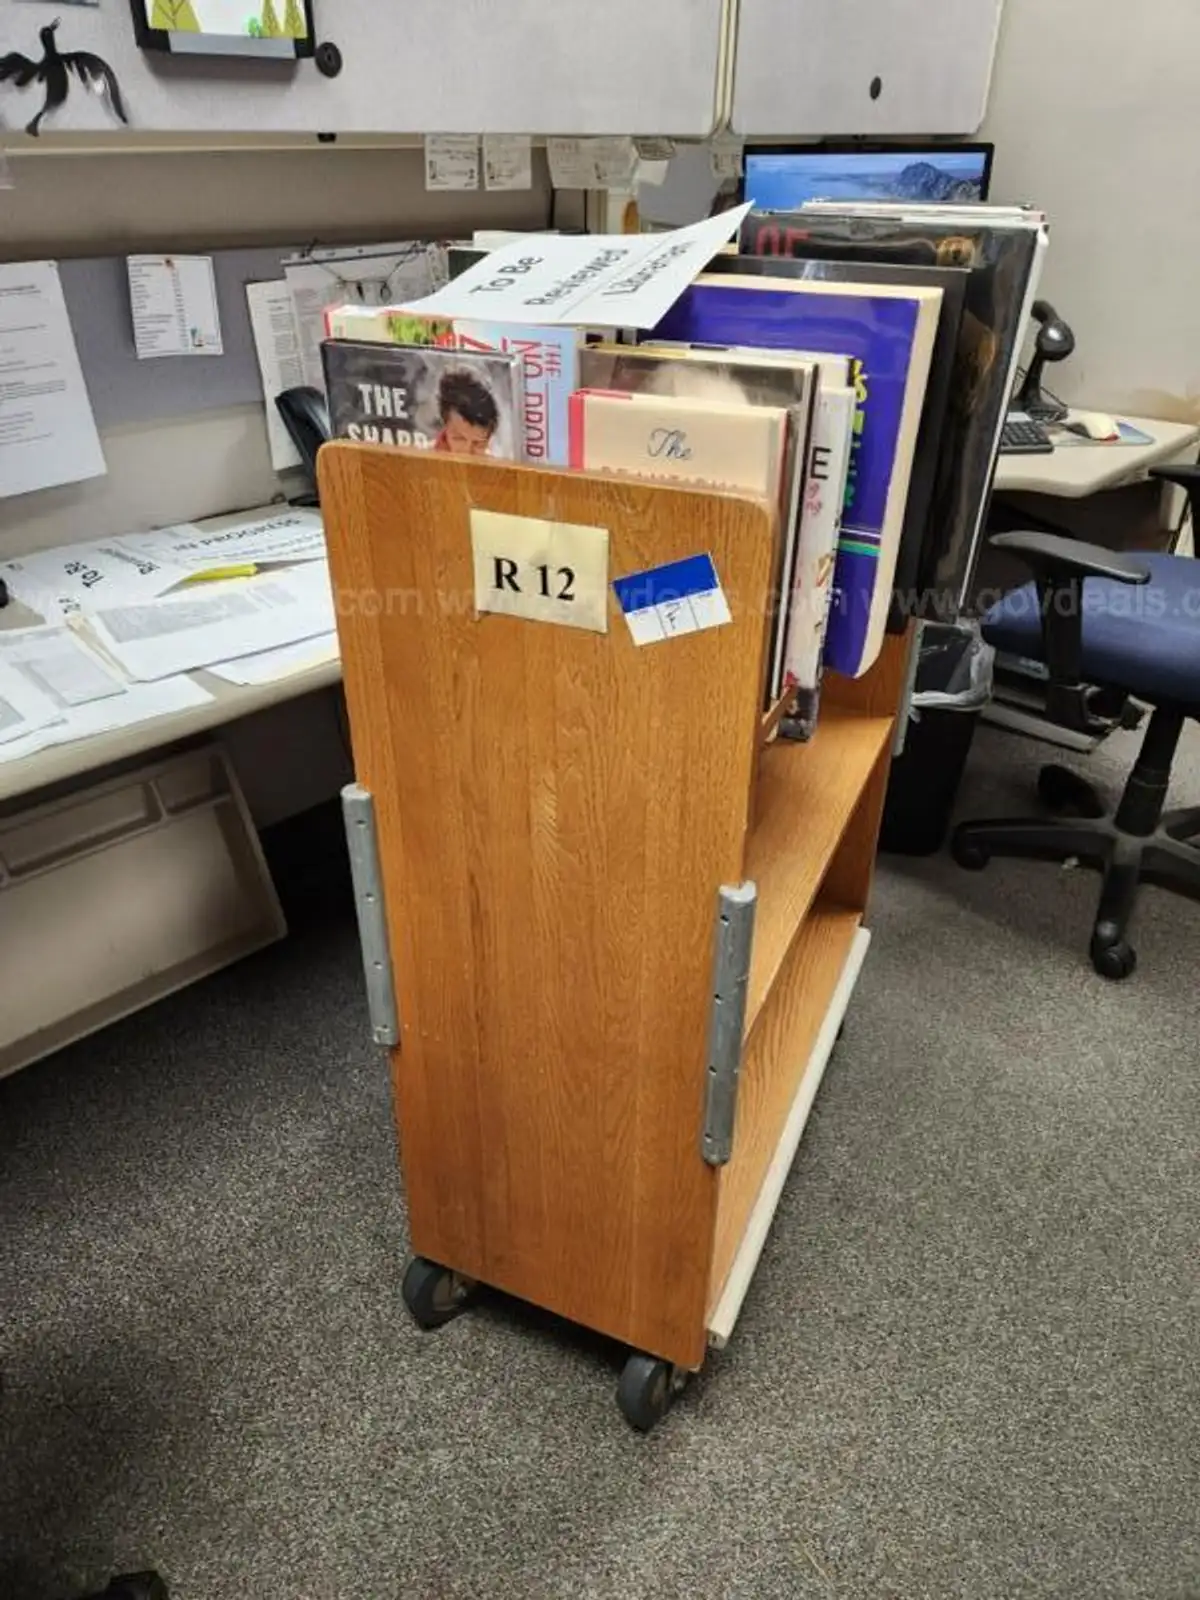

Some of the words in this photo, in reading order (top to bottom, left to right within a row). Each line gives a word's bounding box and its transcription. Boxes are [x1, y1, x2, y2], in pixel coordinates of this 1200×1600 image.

[469, 277, 516, 295] To
[496, 255, 545, 276] Be
[358, 383, 409, 419] THE
[647, 427, 693, 460] The
[810, 445, 833, 480] E
[493, 555, 522, 592] R
[535, 563, 576, 601] 12
